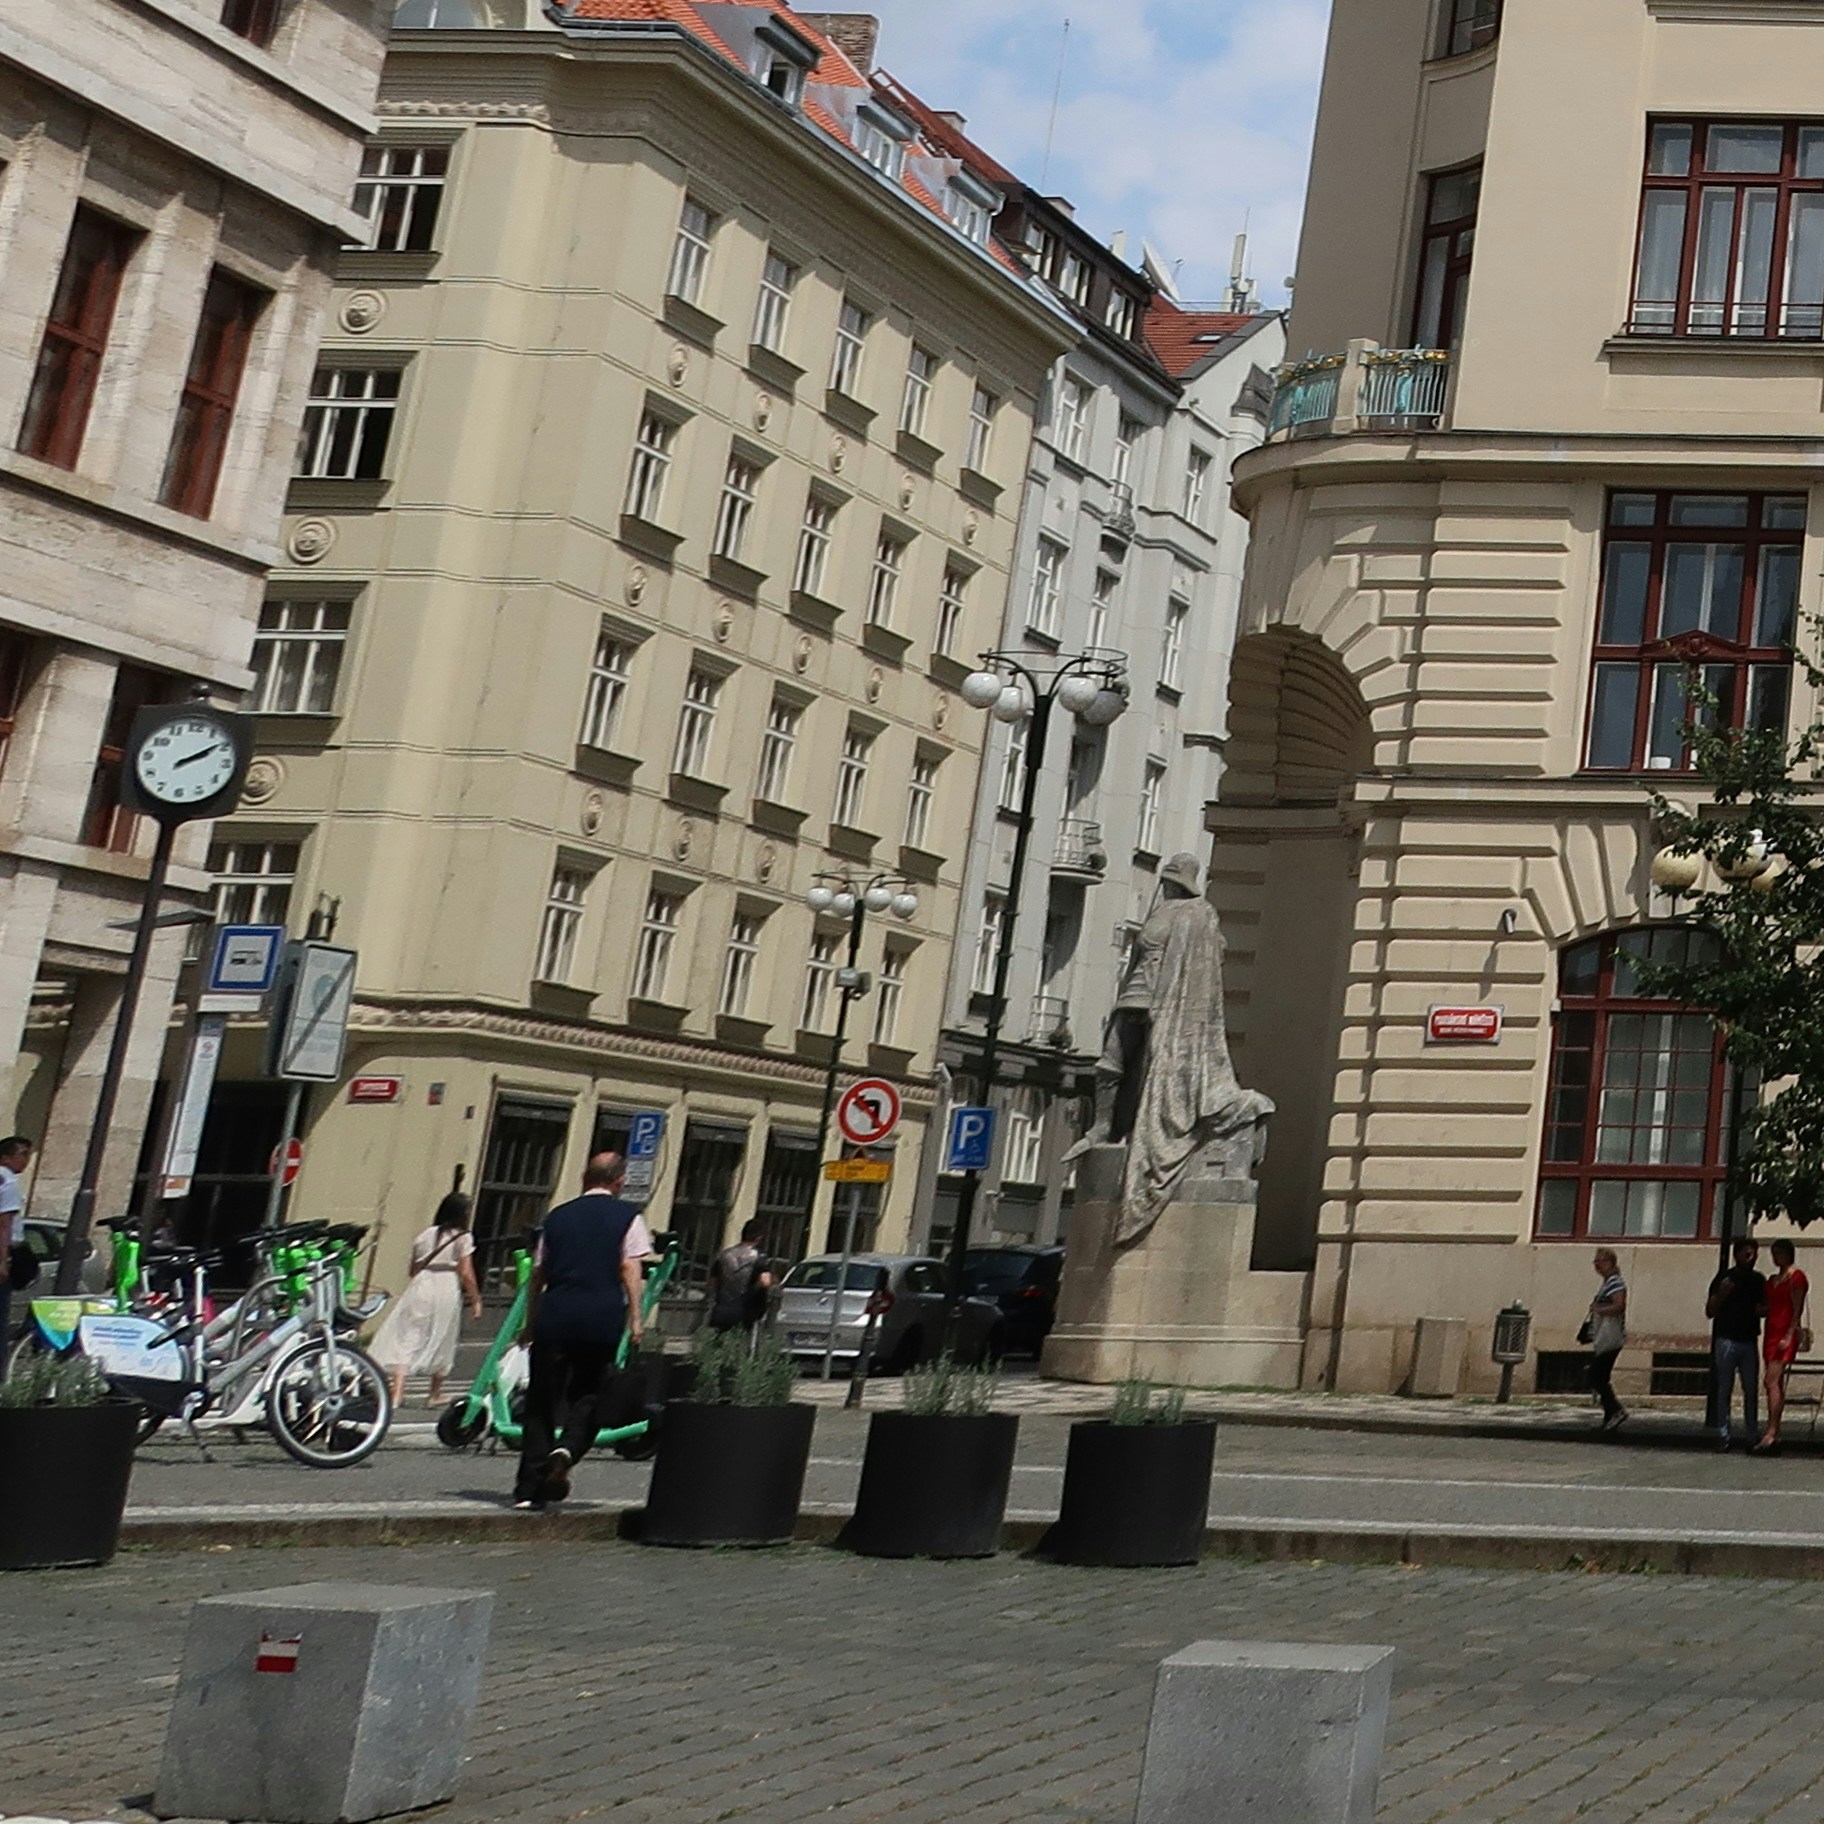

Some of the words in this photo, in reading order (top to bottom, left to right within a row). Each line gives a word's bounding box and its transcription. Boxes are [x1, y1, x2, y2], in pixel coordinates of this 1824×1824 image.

[169, 726, 182, 736] 11
[188, 722, 204, 733] 12
[152, 737, 171, 747] 10
[174, 788, 184, 798] 6
[635, 1117, 656, 1144] P
[959, 1115, 985, 1149] P
